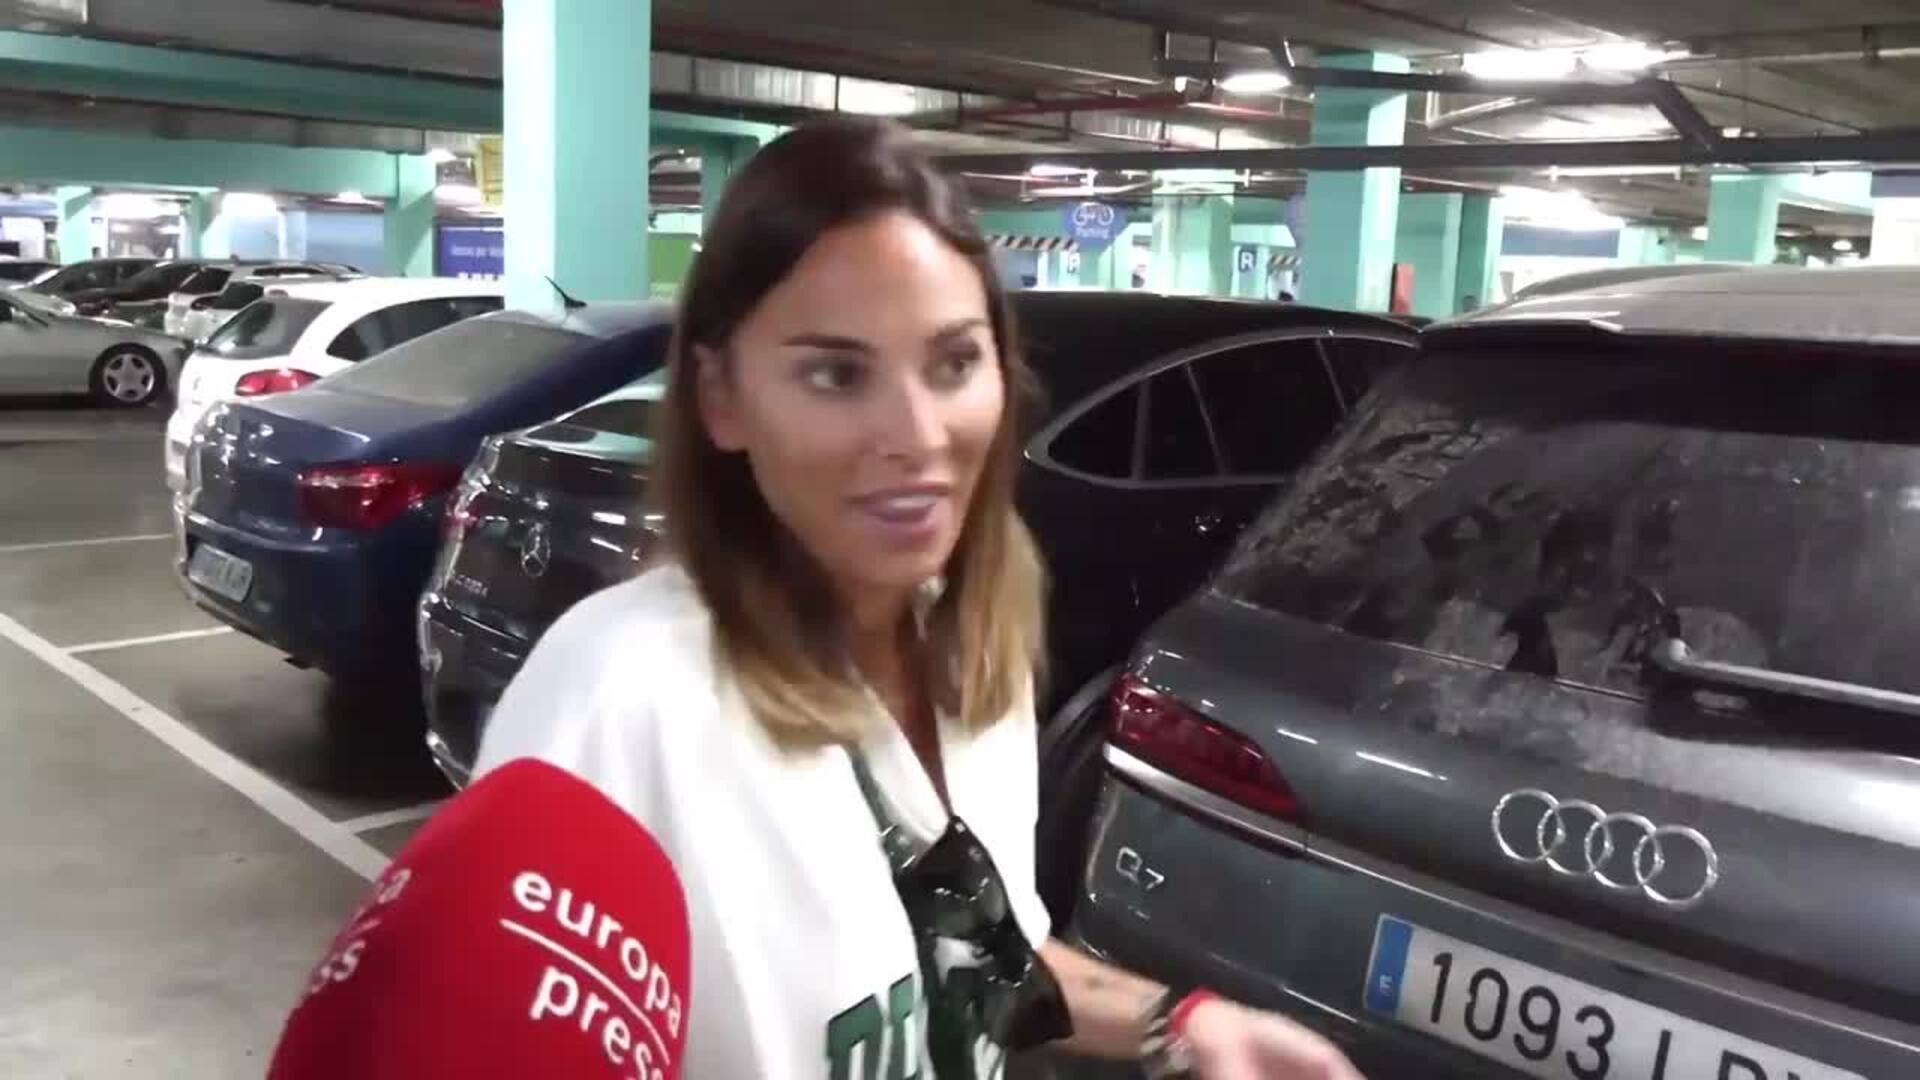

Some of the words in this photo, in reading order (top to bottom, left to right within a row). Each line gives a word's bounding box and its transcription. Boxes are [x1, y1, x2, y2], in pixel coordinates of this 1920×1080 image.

[1240, 251, 1255, 271] R
[512, 871, 681, 1039] europa
[530, 966, 663, 1080] pres
[1430, 952, 1615, 1080] 1093
